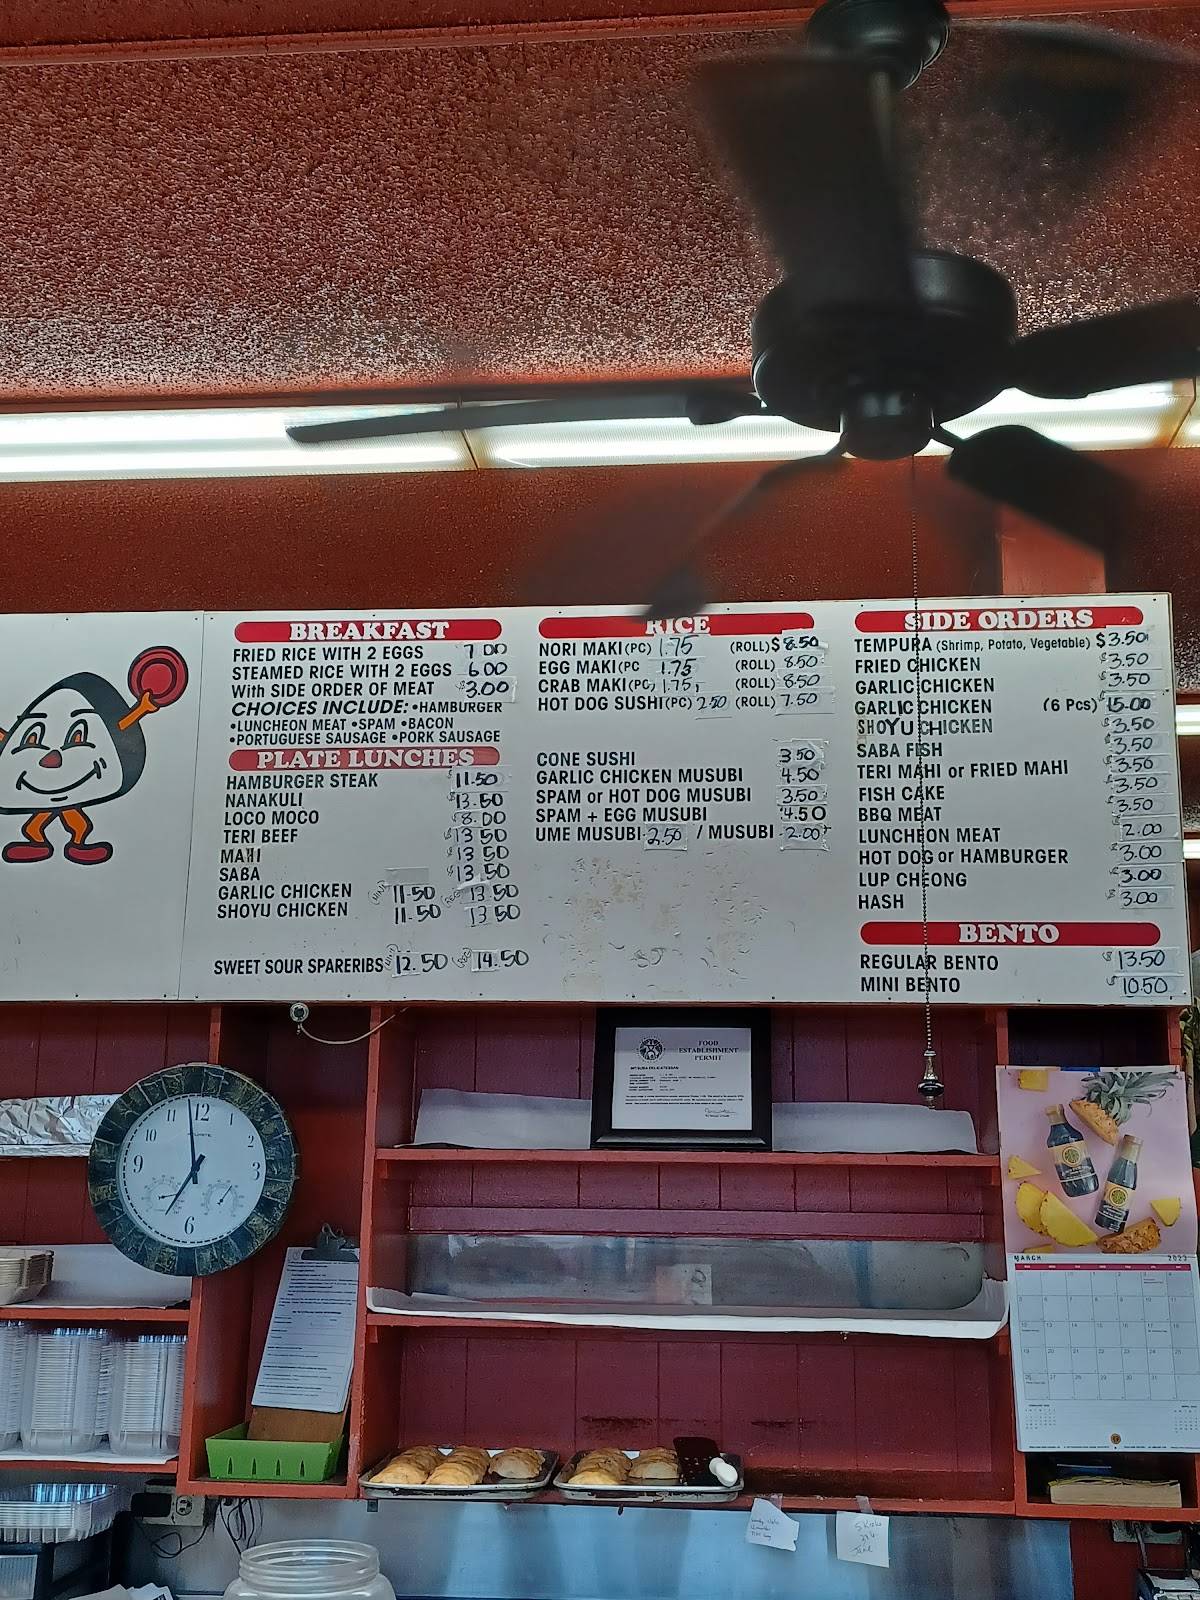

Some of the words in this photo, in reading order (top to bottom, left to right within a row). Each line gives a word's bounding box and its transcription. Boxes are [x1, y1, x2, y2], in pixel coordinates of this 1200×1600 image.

[645, 616, 710, 634] RICE
[905, 611, 971, 630] SIDE
[978, 610, 1093, 629] ORDERS
[290, 621, 449, 641] BREAKFAST
[539, 643, 576, 657] NORI
[855, 638, 932, 653] TEMPURA
[936, 639, 983, 652] (Shrimp,
[988, 639, 1026, 651] Potato,
[1030, 637, 1090, 650] Vegetable)
[233, 649, 276, 662] FRIED
[282, 648, 316, 661] RICE
[322, 647, 361, 661] WITH
[367, 646, 377, 659] 2
[383, 646, 423, 659] EGGS
[232, 666, 304, 680] STEAMED
[309, 666, 344, 679] RICE
[351, 665, 389, 678] WITH
[395, 664, 405, 677] 2
[411, 663, 452, 677] EGGS
[539, 661, 569, 675] EGG
[735, 660, 776, 672] (ROLL)
[855, 659, 900, 673] FRIED
[907, 657, 980, 672] CHICKEN
[232, 684, 265, 699] With
[270, 684, 305, 698] SIDE
[312, 683, 364, 697] ORDER
[369, 683, 387, 696] OF
[393, 682, 434, 696] MEAT
[539, 679, 580, 693] CRAB
[735, 678, 776, 690] (ROLL)
[855, 680, 914, 694] GARLIC
[920, 678, 994, 693] CHICKEN
[231, 701, 317, 716] CHOICES
[322, 700, 408, 715] INCLUDE:
[538, 698, 568, 712] HOT
[575, 697, 608, 711] DOG
[735, 696, 776, 709] (ROLL)
[855, 701, 914, 715] GARLIC
[920, 699, 992, 714] CHICKEN
[1043, 700, 1061, 712] (6
[1066, 699, 1098, 713] Pcs)
[312, 718, 346, 731] MEAT
[857, 718, 913, 736] SHOYU
[920, 719, 993, 735] CHICKEN
[325, 732, 386, 744] SAUSAGE
[439, 730, 500, 743] SAUSAGE
[257, 751, 341, 768] PLATE
[349, 749, 475, 768] LUNCHES
[857, 743, 900, 758] SABA
[906, 743, 943, 757] FISH
[537, 752, 579, 766] CONE
[587, 752, 635, 766] SUSHI
[537, 770, 595, 784] GARLIC
[600, 769, 672, 783] CHICKEN
[678, 768, 743, 782] MUSUBI
[782, 768, 819, 783] 4.50
[857, 765, 891, 779] TERI
[898, 764, 941, 779] MAHI
[948, 765, 964, 778] or
[970, 762, 1017, 777] FRIED
[1025, 760, 1068, 775] MAHI
[227, 775, 324, 789] HAMBURGER
[330, 773, 378, 788] STEAK
[225, 793, 303, 808] NANAKULI
[537, 790, 580, 804] SPAM
[588, 791, 603, 803] or
[608, 789, 640, 803] HOT
[646, 789, 681, 802] DOG
[687, 788, 751, 802] MUSUBI
[859, 787, 895, 802] FISH
[902, 786, 945, 801] CAKE
[224, 811, 265, 825] LOCO
[272, 810, 319, 824] MOCO
[536, 809, 580, 822] SPAM
[604, 809, 636, 822] EGG
[643, 807, 707, 821] MUSUBI
[859, 808, 891, 822] BBQ
[898, 807, 941, 822] MEAT
[224, 829, 255, 844] TERI
[262, 829, 298, 843] BEEF
[536, 828, 571, 842] UME
[577, 826, 641, 841] MUSUBI
[709, 825, 774, 839] MUSUBI
[859, 828, 949, 844] LUNCHEON
[957, 828, 1000, 843] MEAT
[221, 848, 261, 864] MAHI
[860, 851, 891, 865] HOT
[898, 850, 933, 865] DOG
[938, 852, 953, 864] or
[960, 849, 1068, 864] HAMBURGER
[220, 867, 260, 881] SABA
[859, 873, 889, 887] LUP
[896, 872, 967, 887] CHEONG
[218, 885, 275, 900] GARLIC
[281, 883, 351, 899] CHICKEN
[858, 894, 904, 910] HASH
[217, 903, 271, 919] SHOYU
[278, 902, 348, 917] CHICKEN
[958, 923, 1059, 944] BENTO
[214, 961, 260, 975] SWEET
[265, 959, 303, 974] SOUR
[308, 958, 384, 973] SPARERIBS
[861, 955, 936, 970] REGULAR
[944, 955, 999, 970] BENTO
[861, 977, 899, 993] MINI
[906, 977, 960, 992] BENTO
[166, 1109, 176, 1122] 11
[194, 1103, 210, 1121] 12
[229, 1113, 234, 1126] 1
[146, 1129, 157, 1142] 10
[247, 1135, 255, 1148] 2
[133, 1155, 143, 1173] 9
[252, 1162, 261, 1181] 3
[184, 1216, 195, 1234] 6
